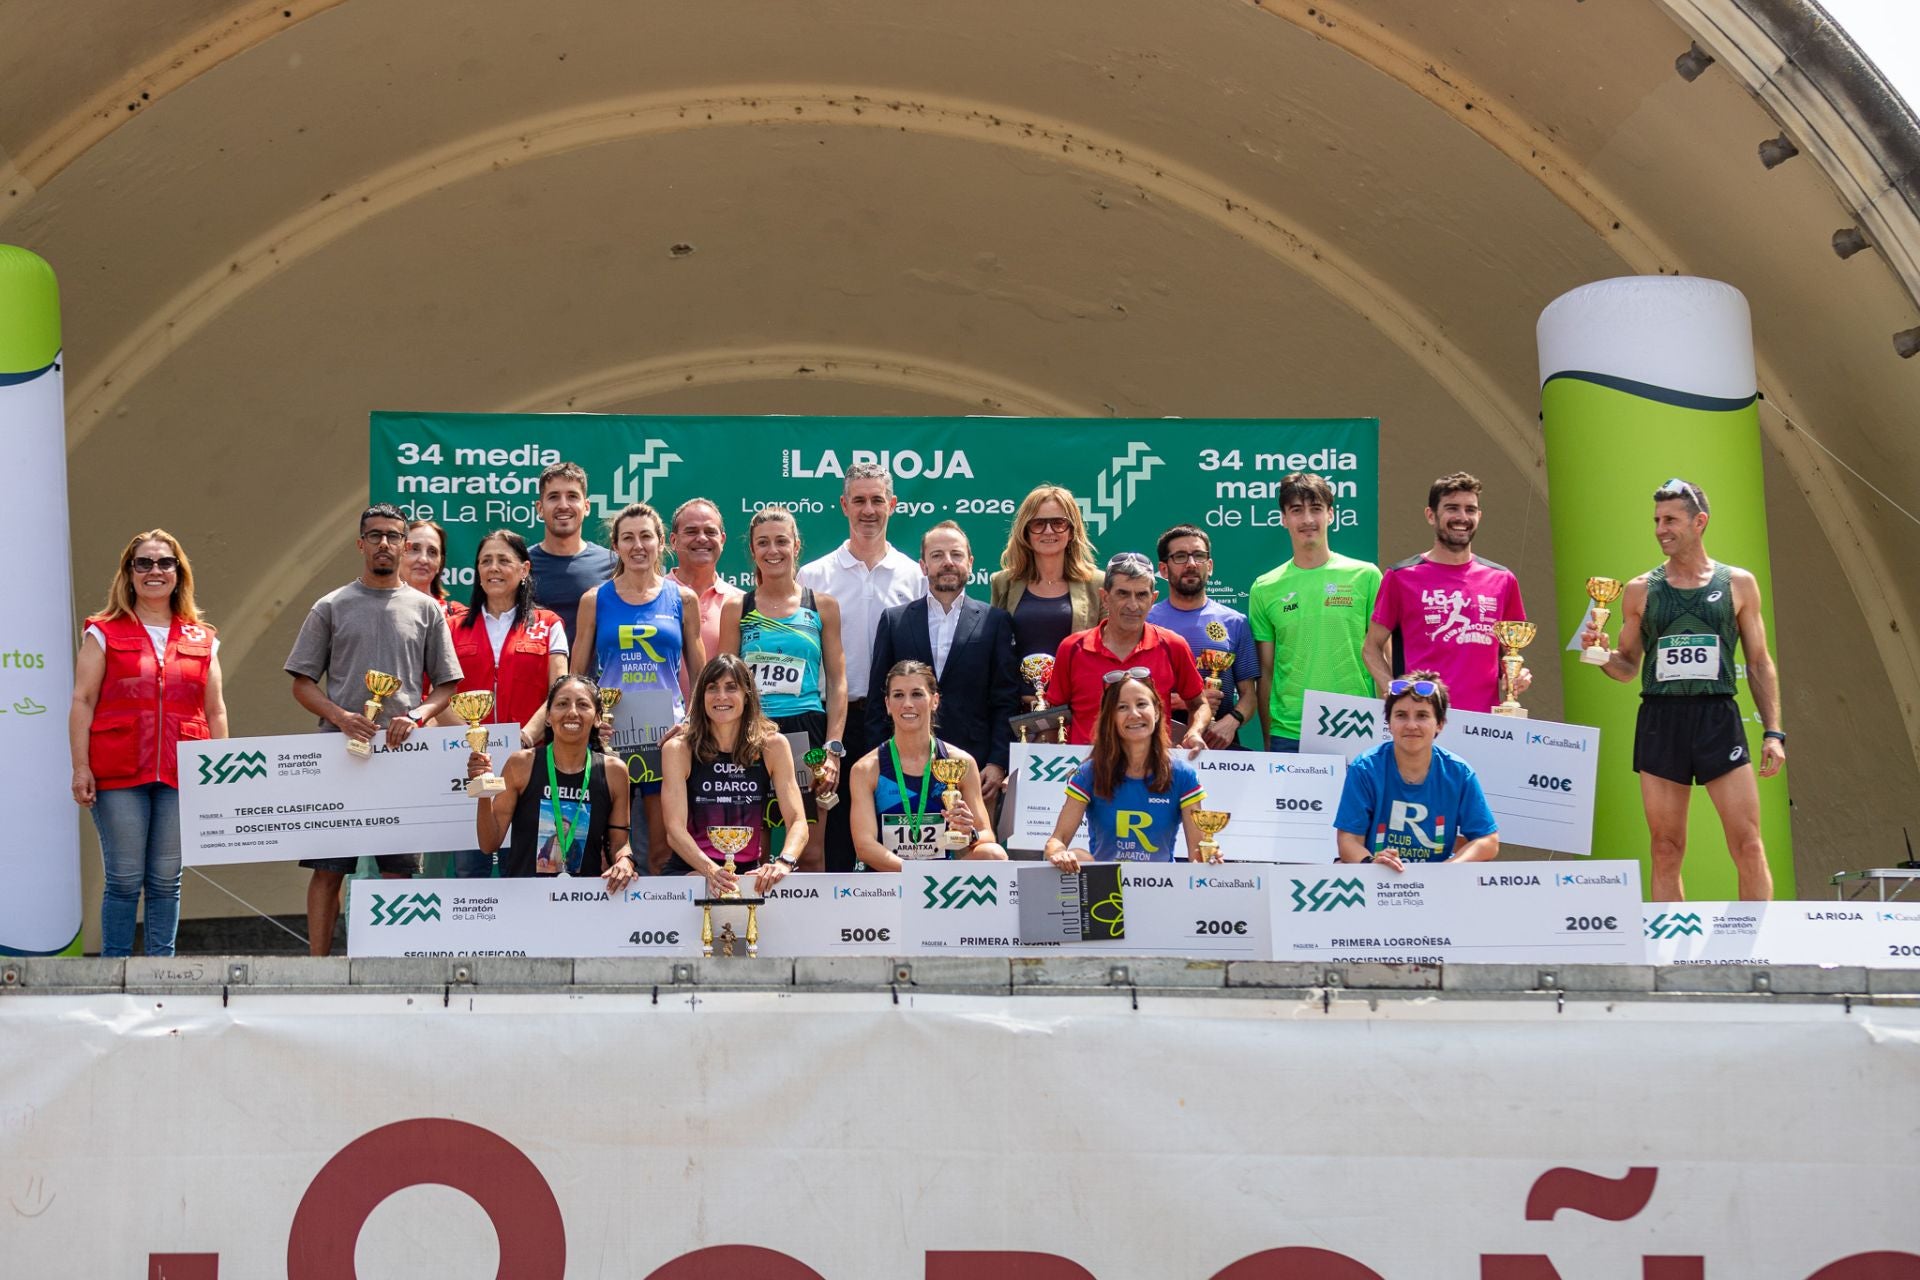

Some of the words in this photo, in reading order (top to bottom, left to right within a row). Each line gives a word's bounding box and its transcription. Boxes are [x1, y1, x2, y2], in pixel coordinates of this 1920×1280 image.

[397, 443, 443, 465] 34
[455, 444, 561, 466] media
[1199, 449, 1243, 471] 34
[1255, 449, 1357, 471] media
[792, 449, 845, 478] LA
[397, 472, 540, 494] maratón
[1216, 476, 1357, 499] marón
[399, 499, 434, 521] de
[443, 500, 478, 522] La
[896, 500, 935, 517] ayo
[955, 499, 1015, 514] 2026
[1206, 505, 1242, 527] de
[1251, 505, 1284, 527] La
[621, 652, 641, 661] CLUB
[1667, 648, 1707, 665] 586
[622, 672, 657, 683] RIOJA
[749, 664, 799, 683] 1180
[1465, 725, 1479, 735] LA
[1481, 727, 1513, 741] RIOJA
[374, 744, 390, 753] LA
[1543, 736, 1580, 750] CaixaBank
[278, 760, 317, 768] maratón
[1201, 762, 1216, 770] LA
[1219, 763, 1255, 771] RIOJA
[1287, 764, 1328, 774] CaixaBank
[702, 781, 712, 792] O
[715, 781, 758, 792] BARCO
[1528, 774, 1572, 791] 400€
[544, 785, 590, 801] QELLCA
[235, 806, 273, 815] TERCER
[277, 803, 344, 813] CLASIFICADO
[1276, 799, 1322, 811] 500€
[236, 822, 301, 833] DOSCIENTOS
[304, 819, 362, 829] CINCUENTA
[366, 816, 400, 826] EUROS
[895, 826, 937, 844] 102
[1387, 833, 1412, 846] CLUB
[1117, 840, 1136, 850] CLUB
[1387, 846, 1430, 858] RATÓN
[1122, 877, 1131, 887] A
[1133, 877, 1173, 887] RIOJA
[1209, 878, 1255, 888] CaixaBank
[1393, 881, 1424, 889] media
[1480, 876, 1498, 886] LA
[1500, 876, 1541, 886] RIOJA
[1575, 875, 1621, 885] CaixaBank
[552, 892, 568, 901] LA
[571, 892, 609, 901] RIOJA
[643, 891, 687, 901] CaixaBank
[781, 888, 819, 898] RIOJA
[853, 888, 897, 897] CaixaBank
[1404, 898, 1424, 907] Rioja
[1808, 912, 1824, 920] LA
[1826, 912, 1863, 920] RIOJA
[1195, 920, 1248, 935] 200€
[1565, 916, 1618, 930] 200€
[629, 931, 679, 944] 400€
[841, 928, 890, 942] 500€
[960, 937, 1009, 946] PRIMERA
[1331, 938, 1381, 947] PRIMERA
[1384, 936, 1451, 947] LOGROÑESA
